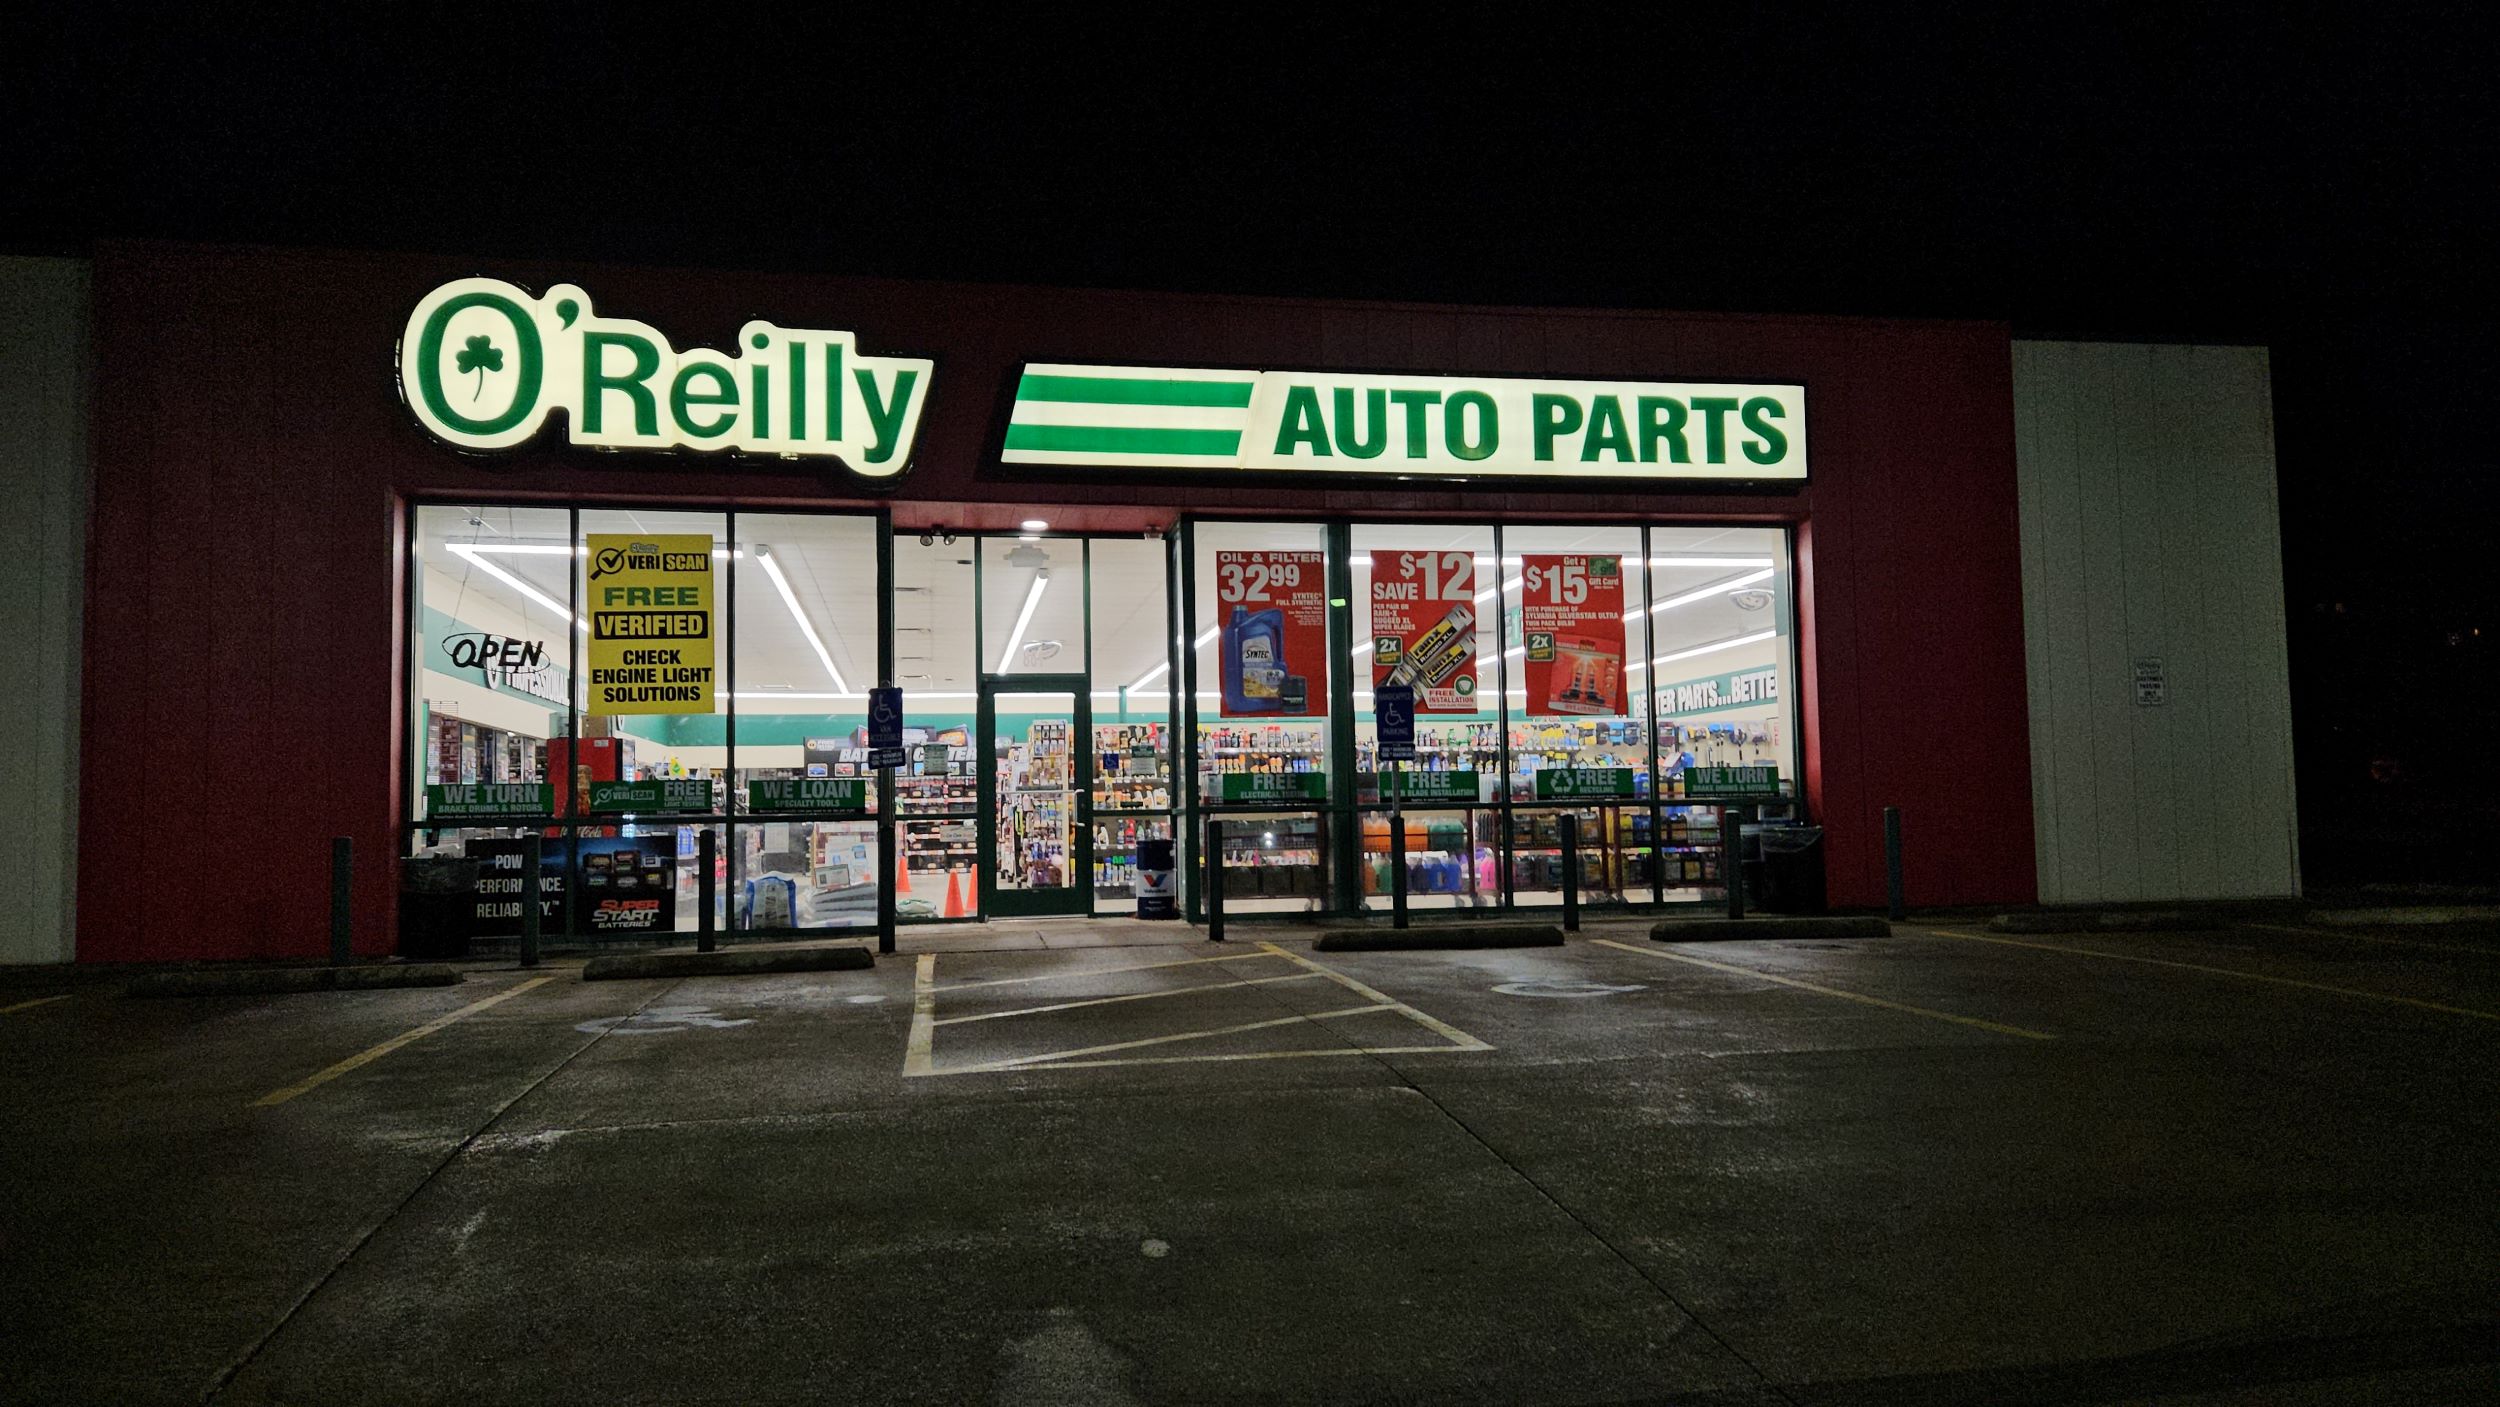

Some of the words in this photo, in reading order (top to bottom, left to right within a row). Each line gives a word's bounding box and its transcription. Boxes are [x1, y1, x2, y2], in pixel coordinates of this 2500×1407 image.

[416, 292, 919, 464] O'Reilly
[1273, 385, 1500, 461] AUTO
[1531, 392, 1788, 465] PARTS
[628, 555, 660, 570] VERI
[666, 554, 706, 570] SCAN
[1219, 552, 1247, 563] OIL
[1252, 553, 1263, 563] &
[1269, 553, 1322, 563] FILTER
[1563, 556, 1579, 566] Get
[1580, 558, 1586, 566] a
[1373, 582, 1418, 600] SAVE
[1400, 552, 1473, 600] $12
[1526, 564, 1588, 604] $15
[1589, 577, 1602, 586] Gift
[1603, 577, 1619, 586] Card
[604, 587, 699, 606] FREE
[598, 614, 704, 636] VERIFIED
[452, 633, 544, 669] OPEN
[623, 649, 682, 665] CHECK
[592, 668, 657, 684] ENGINE
[663, 667, 712, 683] LIGHT
[604, 686, 701, 702] SOLUTIONS
[1634, 688, 1677, 718] BETER
[1252, 773, 1297, 790] FREE
[1408, 772, 1451, 788] FREE
[1576, 769, 1617, 786] FREE
[1695, 768, 1721, 784] WE
[1725, 767, 1768, 784] TURN
[443, 785, 477, 804] WE
[483, 785, 539, 804] TURN
[612, 791, 630, 800] VERI
[632, 790, 654, 800] SCAN
[664, 781, 705, 796] FREE
[762, 781, 794, 799] WE
[800, 780, 852, 799] LOAN
[1240, 790, 1281, 799] ELECTRICAL
[438, 804, 467, 813] BRAKE
[468, 804, 499, 813] DRUMS
[501, 804, 508, 812] &
[510, 803, 543, 812] ROTORS
[774, 799, 815, 808] SPECIALTY
[816, 799, 840, 807] TOOLS
[599, 898, 661, 911] SUPER
[592, 908, 660, 923] START
[597, 921, 652, 929] BATTERIES
